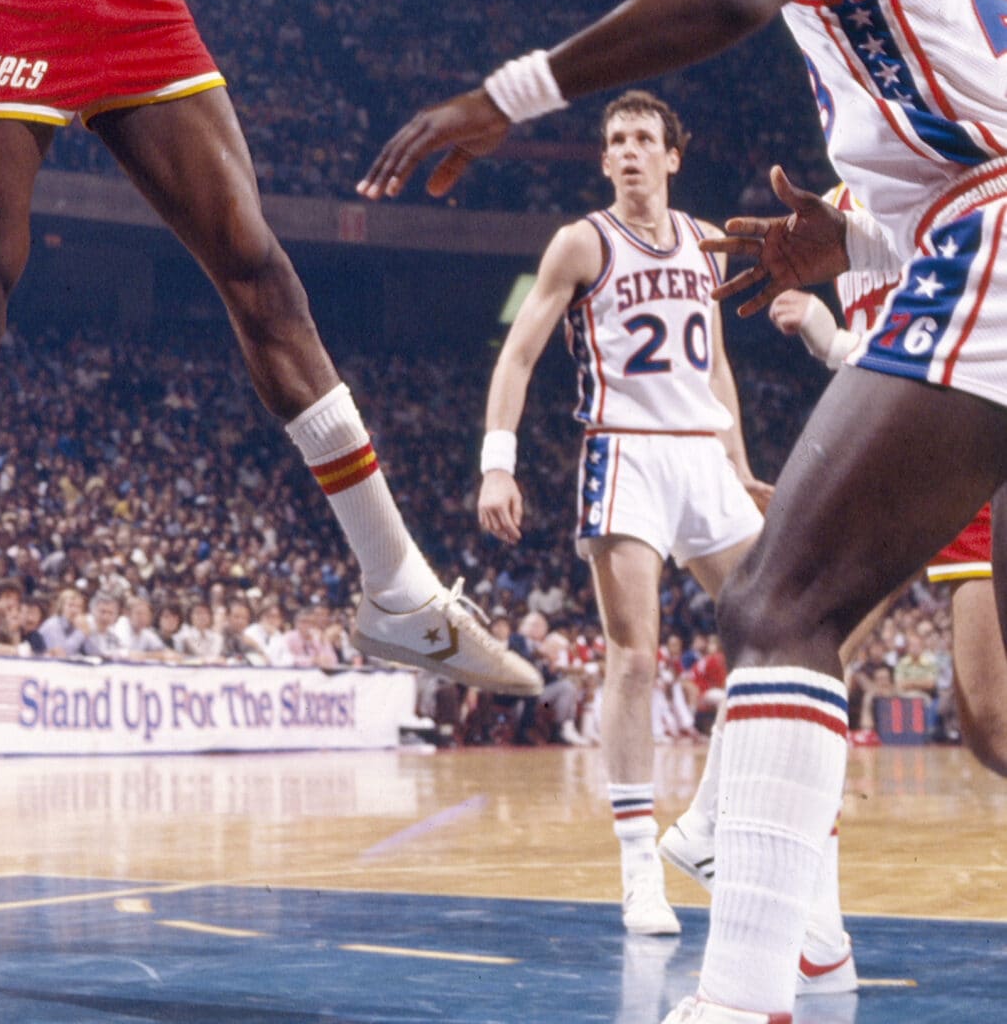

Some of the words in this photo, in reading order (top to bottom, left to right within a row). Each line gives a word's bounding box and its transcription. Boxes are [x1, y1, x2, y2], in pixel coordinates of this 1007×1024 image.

[615, 267, 711, 313] SIXERS
[621, 311, 709, 377] 20
[878, 312, 938, 355] 76
[19, 677, 112, 729] Stand
[121, 682, 162, 742] Up
[170, 683, 216, 729] For
[221, 681, 273, 729] The
[280, 680, 356, 729] Sixers!
